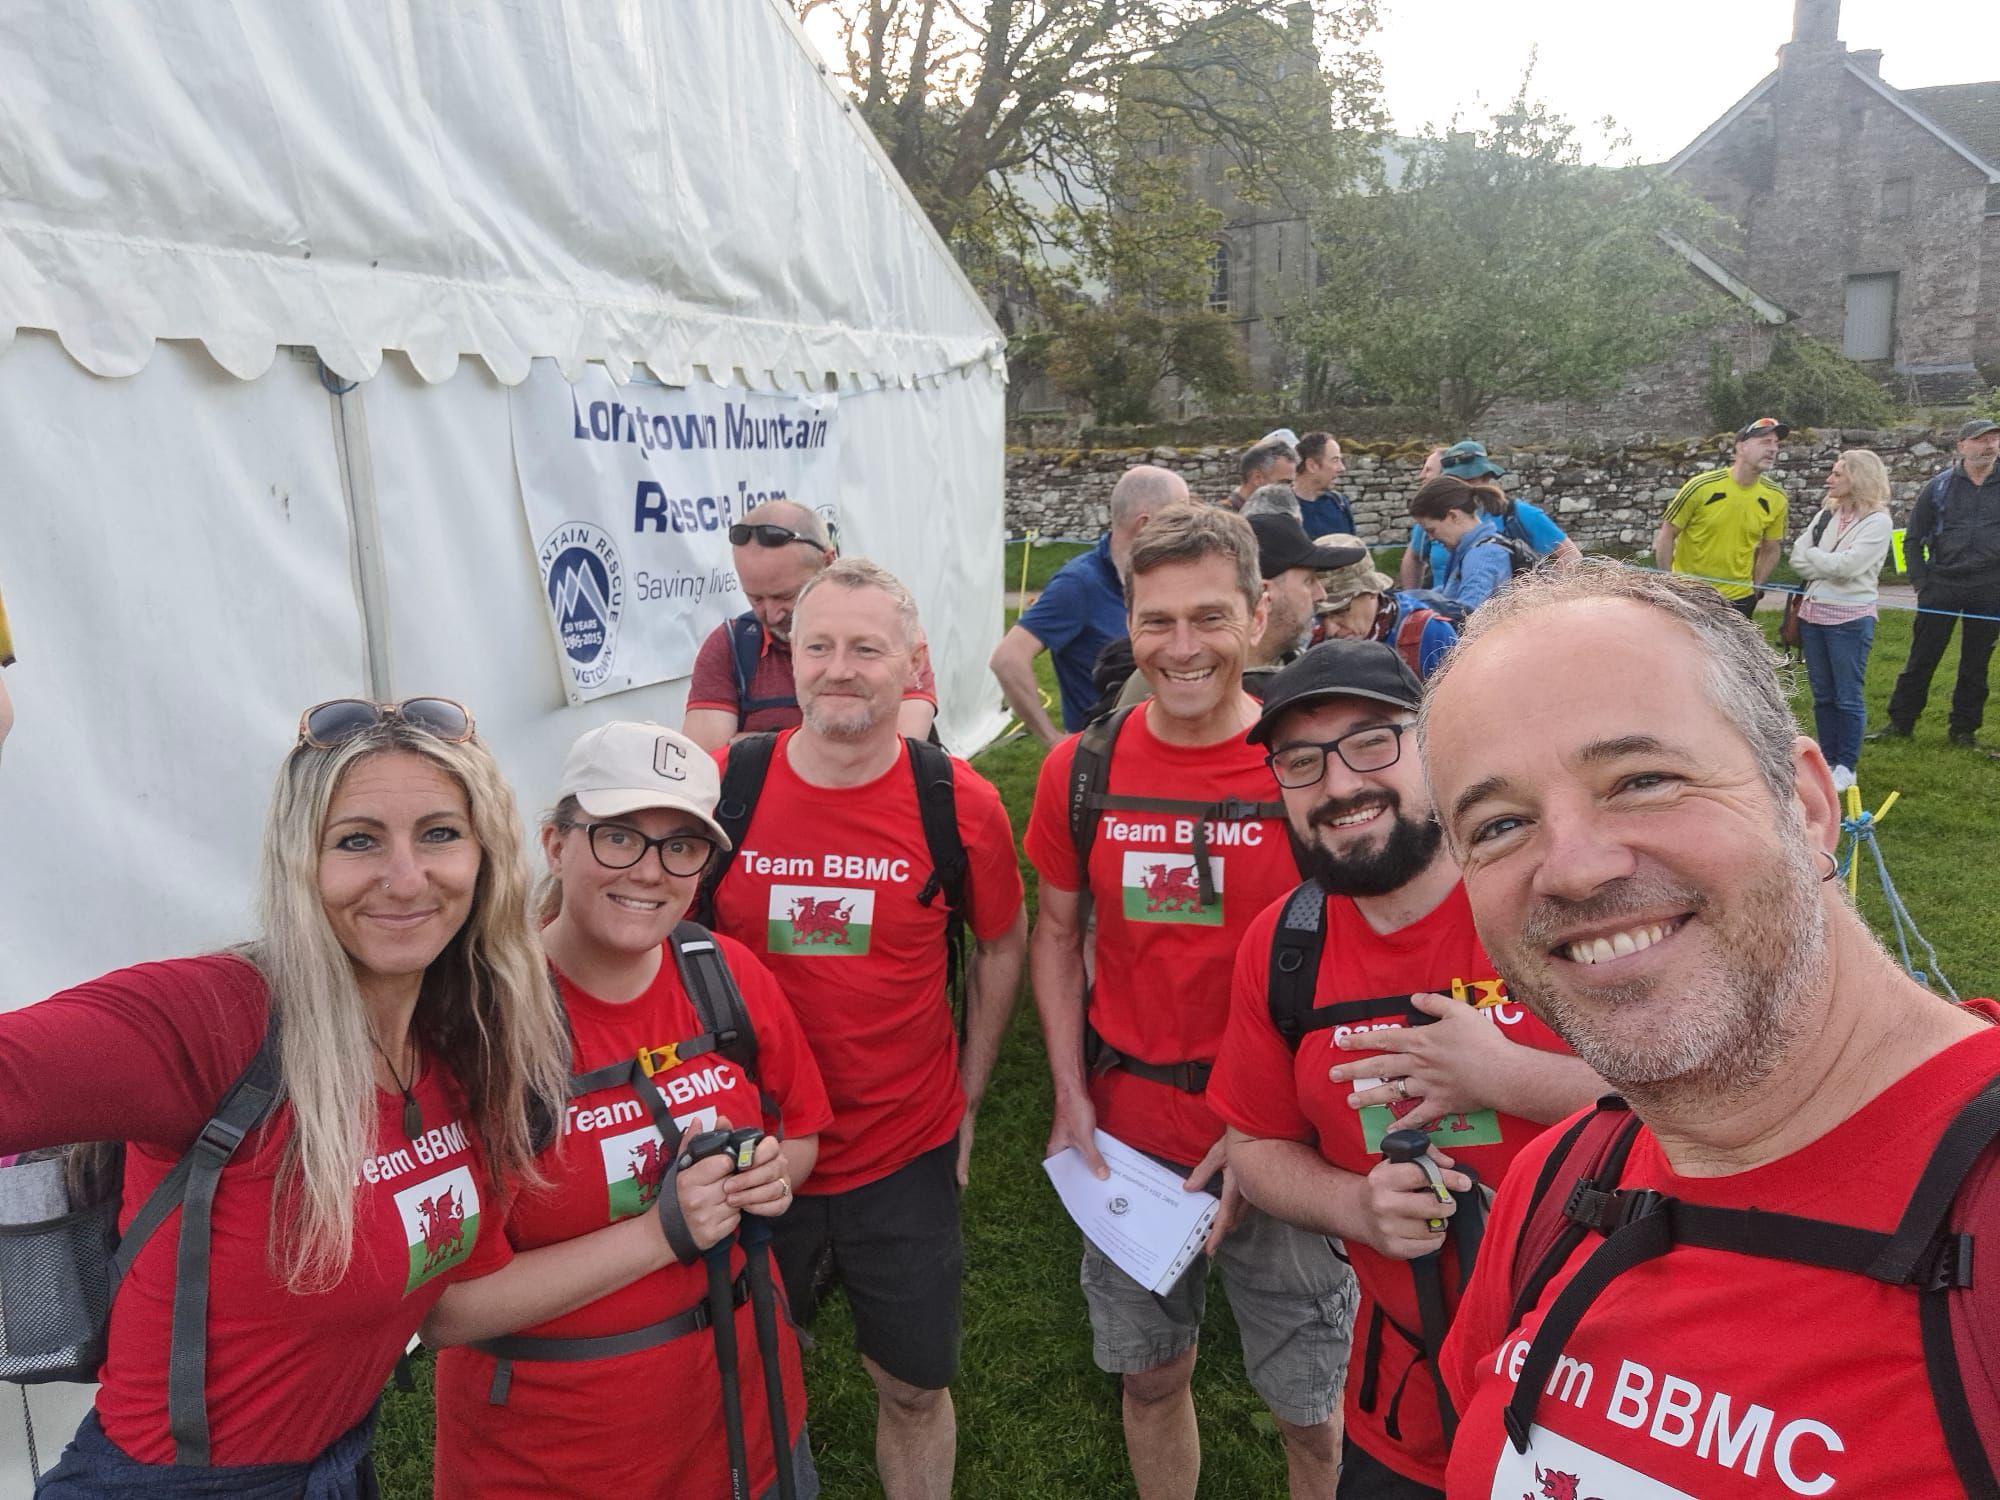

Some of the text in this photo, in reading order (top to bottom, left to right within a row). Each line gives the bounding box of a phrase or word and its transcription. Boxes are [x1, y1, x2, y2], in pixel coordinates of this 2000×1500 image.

[573, 394, 717, 460] Lontown
[595, 537, 622, 623] RESCUE
[574, 619, 598, 631] YEARS
[653, 736, 686, 781] C
[1103, 816, 1167, 843] Team
[741, 850, 910, 883] Team BBMC
[565, 1099, 644, 1136] Team
[354, 1148, 417, 1186] eam
[1605, 1358, 1846, 1496] BBMC
